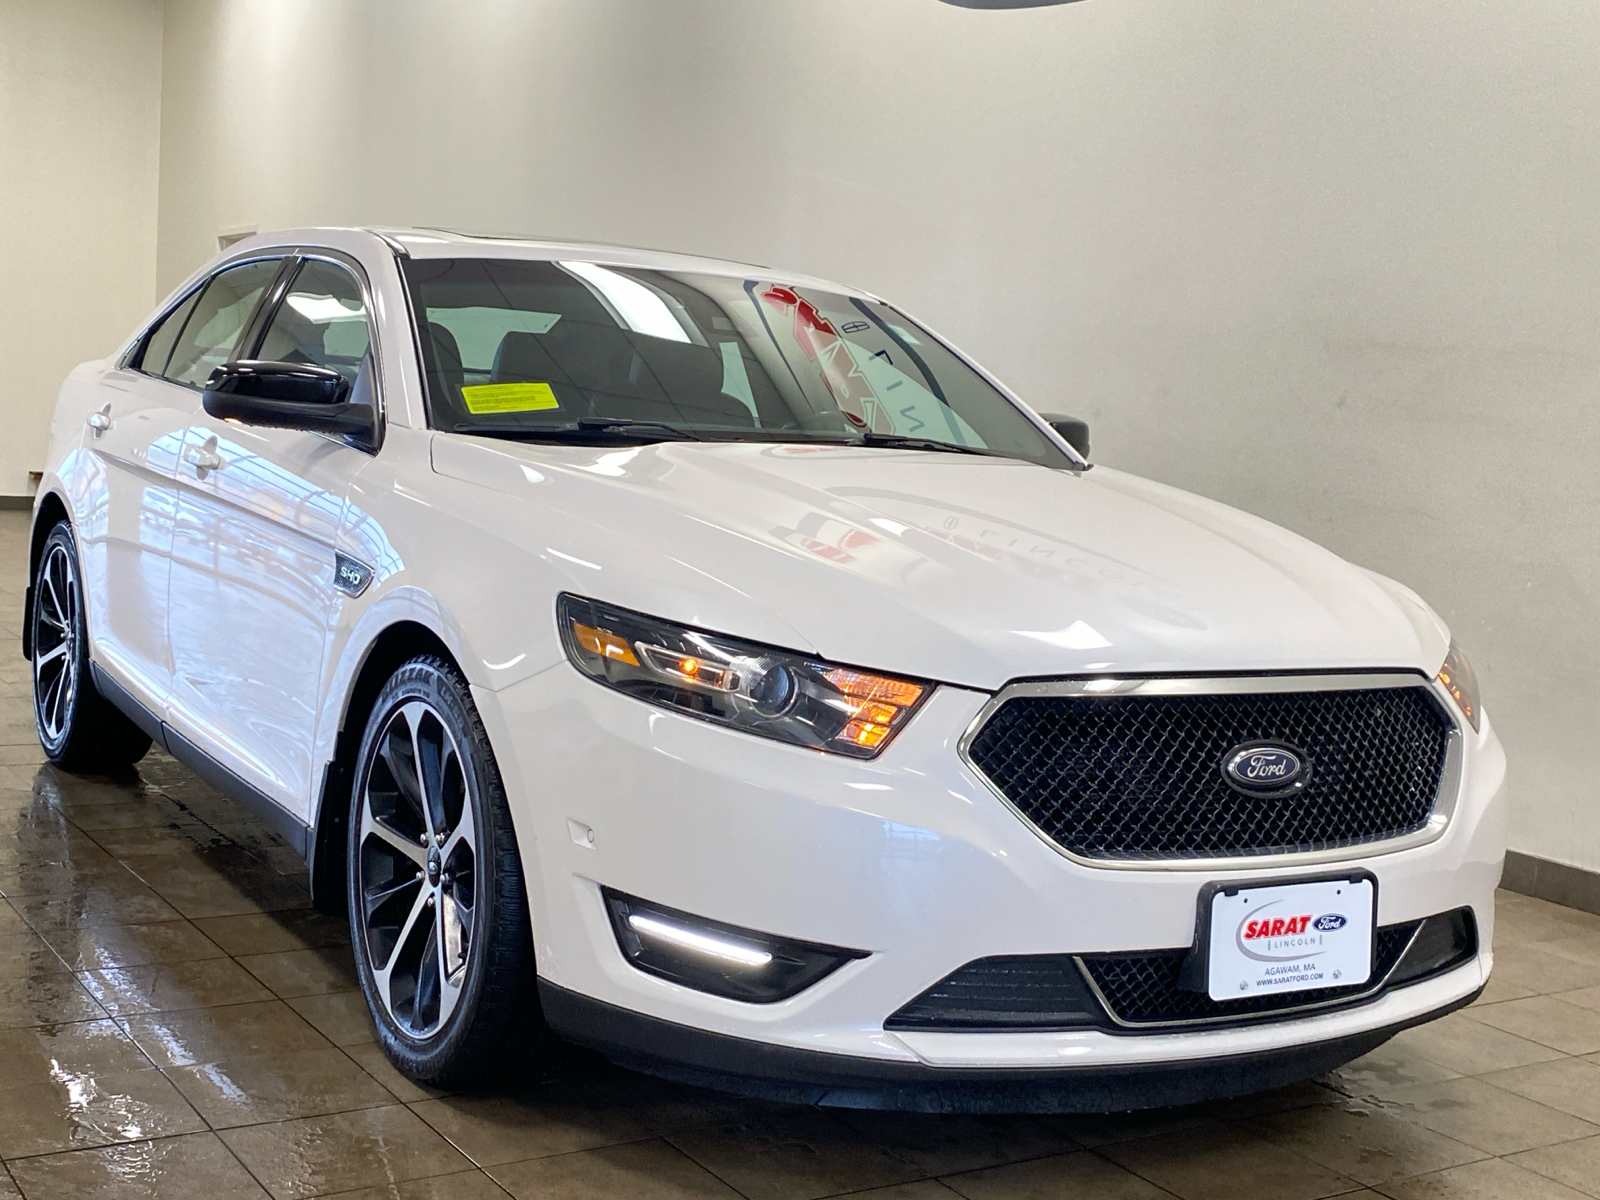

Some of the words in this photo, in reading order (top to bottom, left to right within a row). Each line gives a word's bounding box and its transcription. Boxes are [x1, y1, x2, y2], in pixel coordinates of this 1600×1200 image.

[1247, 755, 1287, 778] Ford
[1243, 914, 1313, 940] SARAT
[1318, 917, 1342, 930] Ford
[1274, 937, 1316, 948] LINCOLN
[1264, 964, 1302, 976] AGAWAM,
[1303, 962, 1316, 972] MA
[1256, 973, 1324, 986] WWW.SARATFORD.COM
